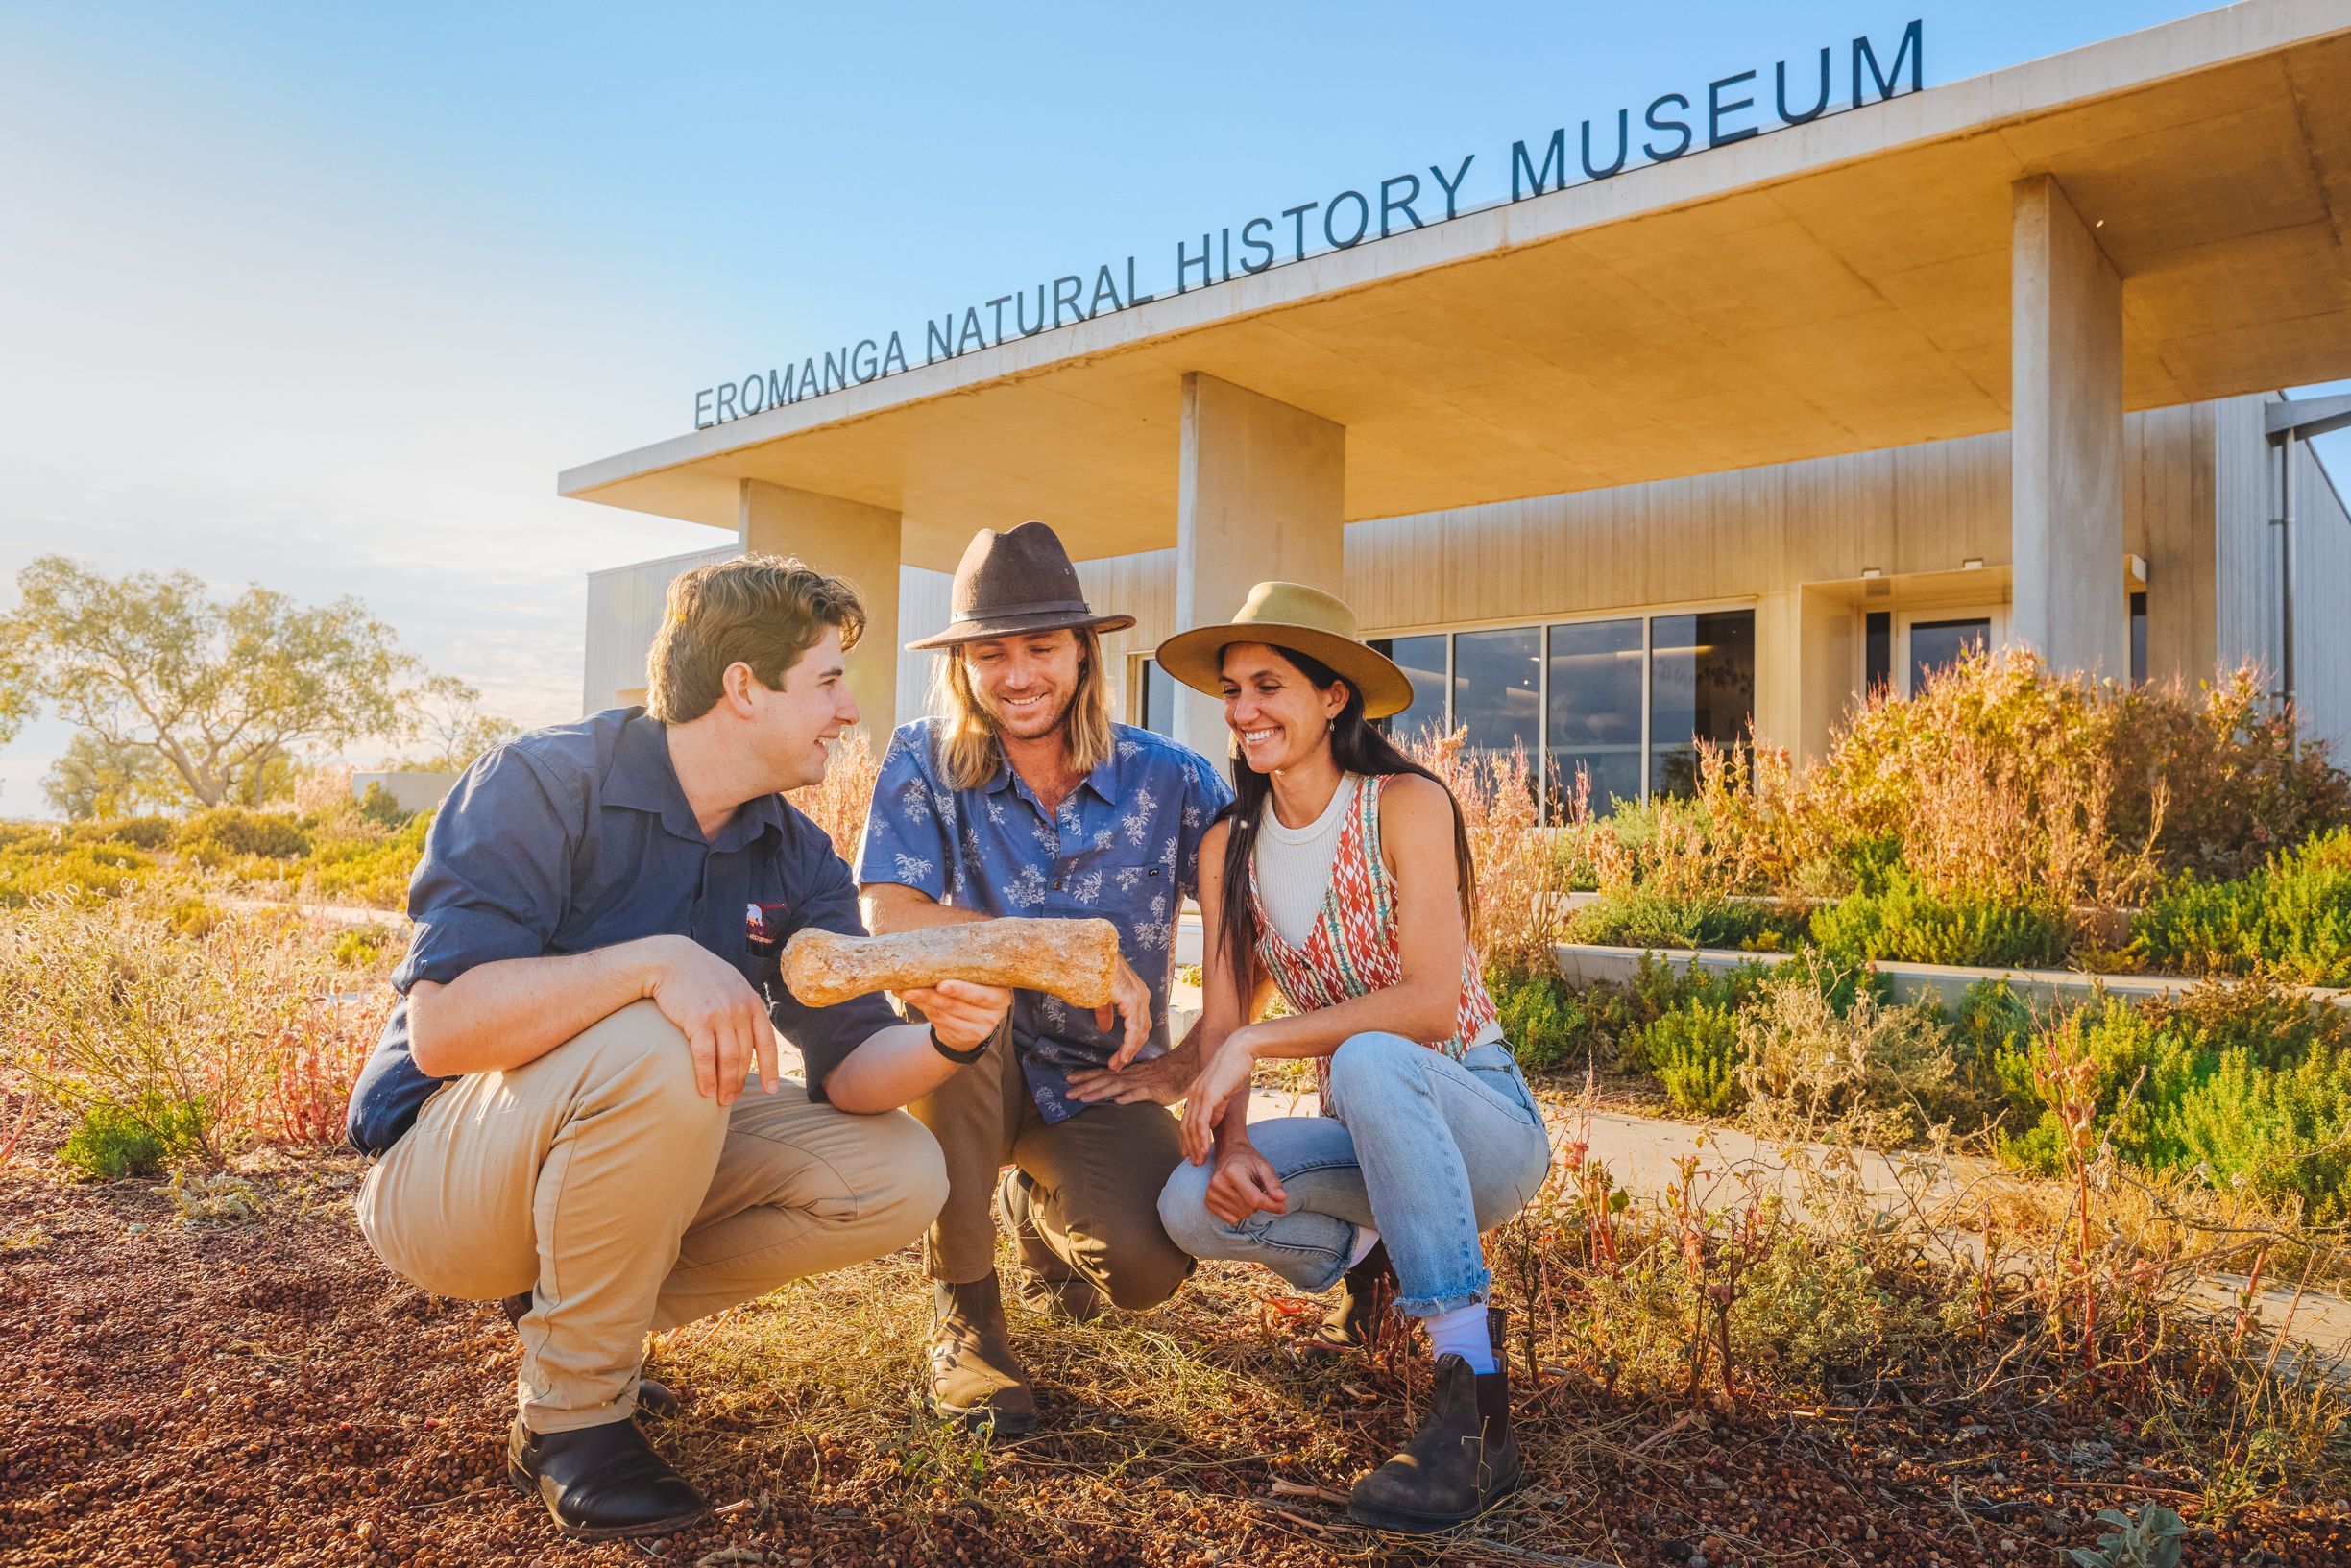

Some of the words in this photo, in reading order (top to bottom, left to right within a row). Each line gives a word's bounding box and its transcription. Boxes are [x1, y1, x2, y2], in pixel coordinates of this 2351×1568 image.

[695, 331, 908, 429] EROMANGA
[927, 256, 1153, 364] NATURAL
[1178, 154, 1475, 293] HISTORY
[1512, 19, 1922, 202] MUSEUM
